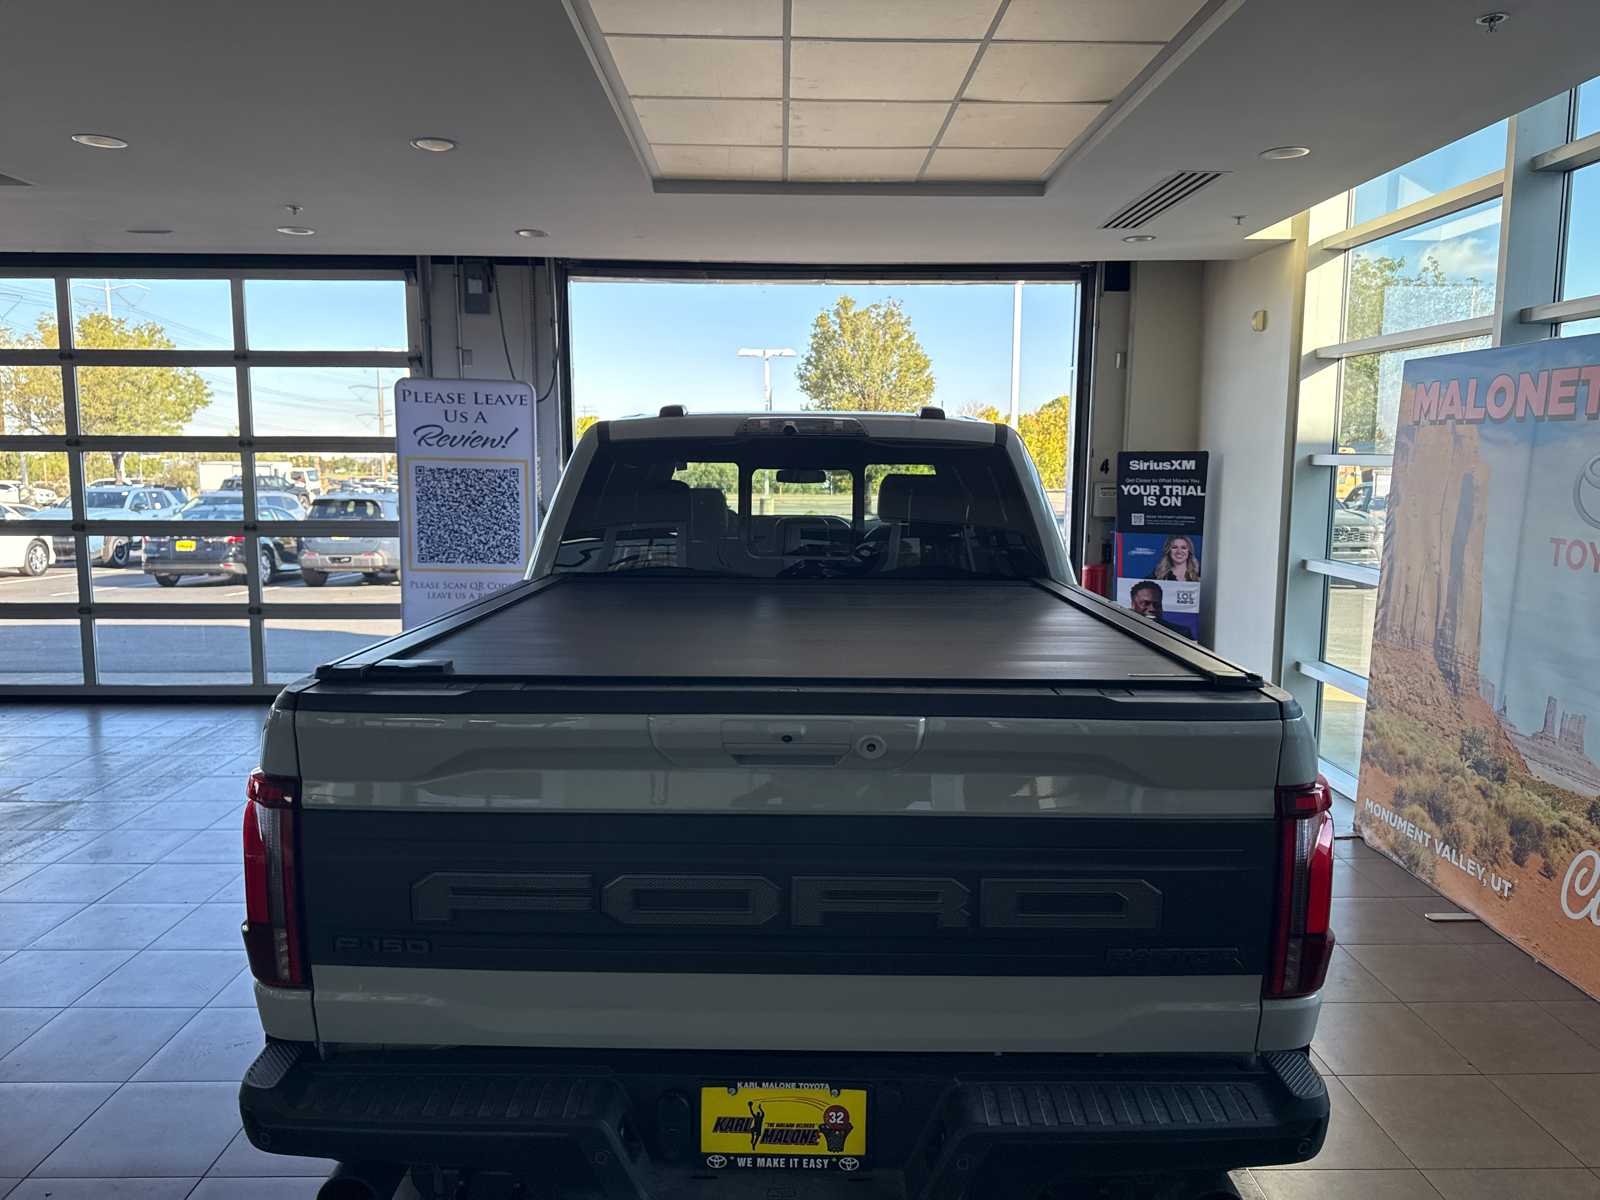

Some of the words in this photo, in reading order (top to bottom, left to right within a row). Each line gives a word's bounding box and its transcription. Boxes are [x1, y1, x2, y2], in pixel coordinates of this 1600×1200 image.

[474, 410, 488, 424] A
[413, 424, 519, 449] Review!
[1100, 458, 1109, 475] 4
[1129, 459, 1196, 471] SiriusXM
[1120, 484, 1160, 496] YOUR
[1162, 485, 1206, 497] TRIAL
[1143, 496, 1157, 507] IS
[1159, 496, 1182, 507] ON
[469, 581, 485, 591] QR
[427, 591, 452, 599] LEAVE
[454, 592, 466, 600] US
[468, 592, 475, 600] A
[1177, 592, 1194, 601] LOL
[1365, 798, 1431, 848] MONUMENT
[1434, 838, 1488, 887] VALLEY,
[1490, 872, 1512, 897] UT
[411, 870, 1163, 930] FORD
[737, 1081, 760, 1089] KARL
[761, 1082, 797, 1090] MALONE
[828, 1111, 844, 1124] 32
[712, 1116, 753, 1134] KARL
[759, 1128, 820, 1146] MALONE
[737, 1157, 753, 1167] WE
[756, 1157, 786, 1168] MAKE
[789, 1158, 799, 1168] IT
[802, 1158, 829, 1169] EASY
